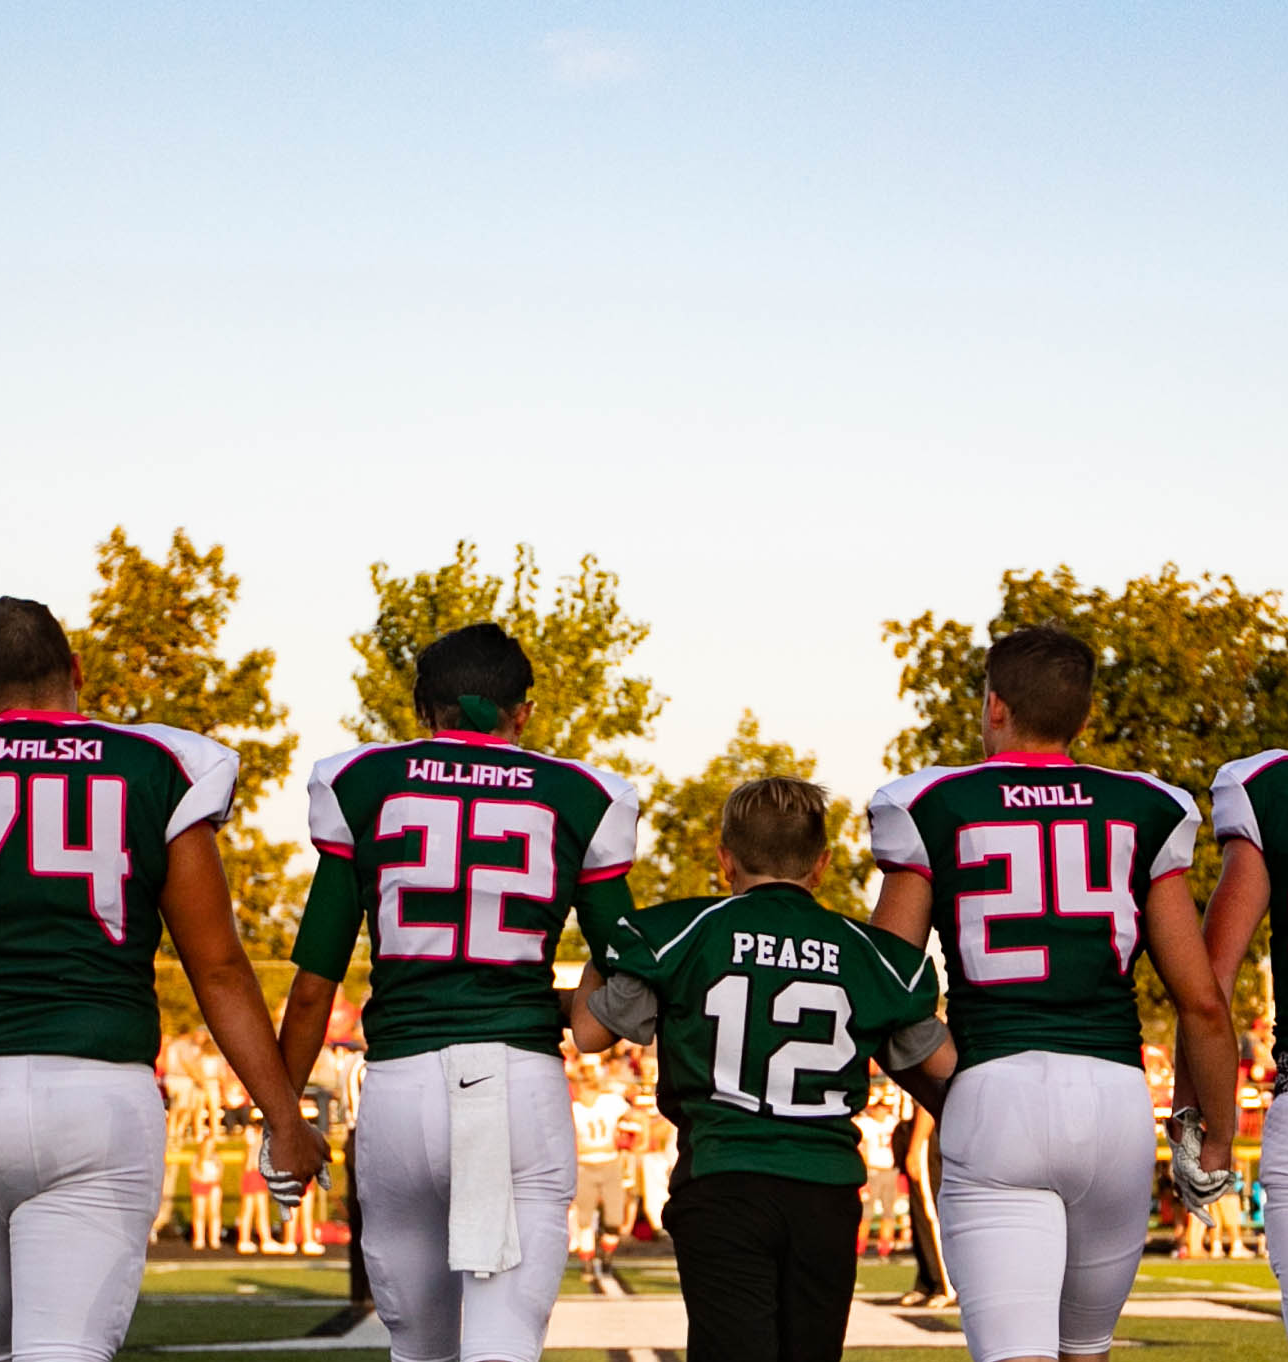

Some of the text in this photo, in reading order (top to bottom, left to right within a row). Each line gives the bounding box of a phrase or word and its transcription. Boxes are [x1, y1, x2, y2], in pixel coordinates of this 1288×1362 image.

[406, 758, 535, 788] WILLIAMS
[374, 792, 558, 965] 22
[955, 820, 1141, 987] 24
[731, 931, 841, 975] PEASE
[704, 974, 857, 1118] 12
